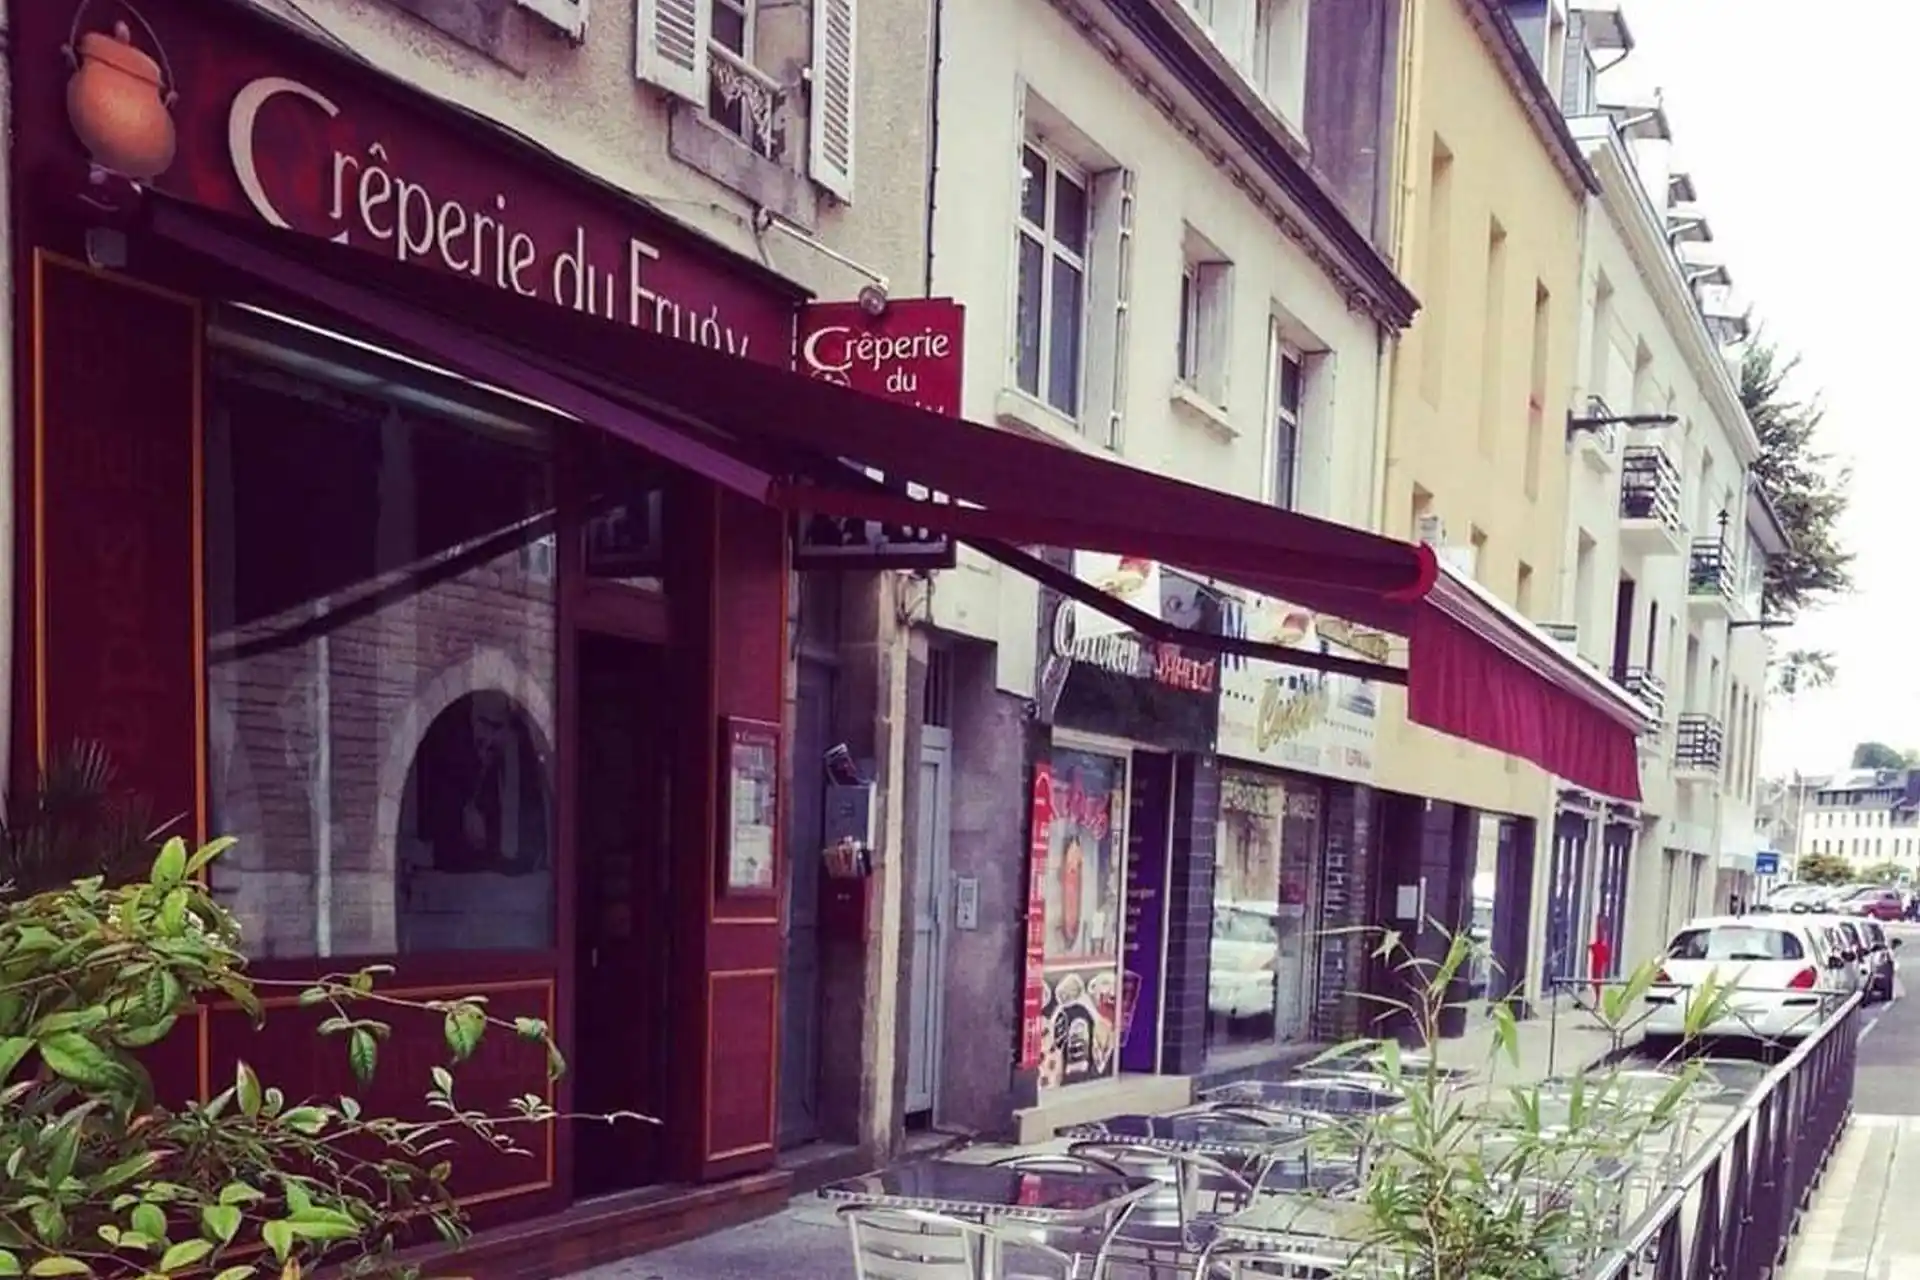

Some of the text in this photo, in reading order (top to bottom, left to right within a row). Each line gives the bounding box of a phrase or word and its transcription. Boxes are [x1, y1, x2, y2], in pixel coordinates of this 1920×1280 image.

[229, 76, 537, 297] Crêperie
[554, 225, 614, 320] du
[803, 326, 950, 371] Crêperie
[886, 367, 917, 392] du
